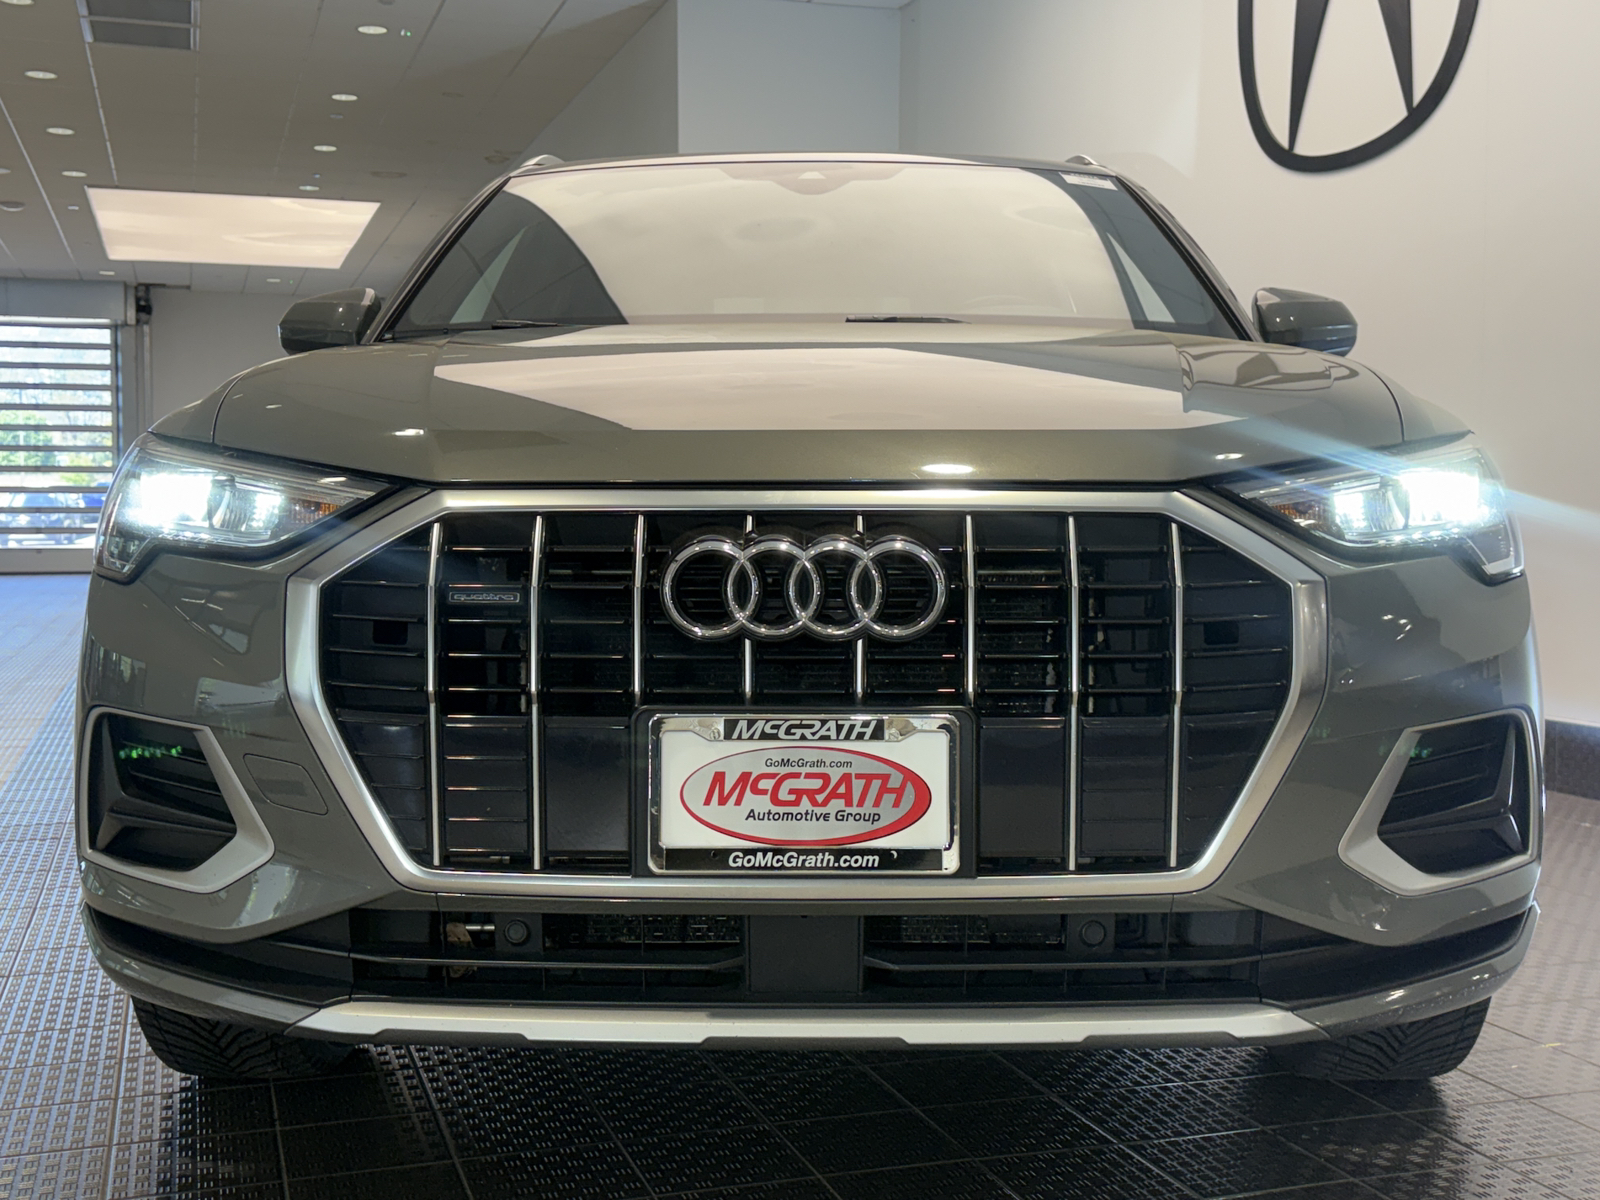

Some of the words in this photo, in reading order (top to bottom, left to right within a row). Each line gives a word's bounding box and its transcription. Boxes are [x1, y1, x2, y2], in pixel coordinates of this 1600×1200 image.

[731, 720, 877, 740] McGRATH
[764, 758, 853, 769] GoMcGrath.com
[702, 771, 908, 808] McGRATH
[745, 809, 831, 822] Automotive
[834, 810, 881, 825] Group
[728, 851, 879, 868] GoMcGrath.com
